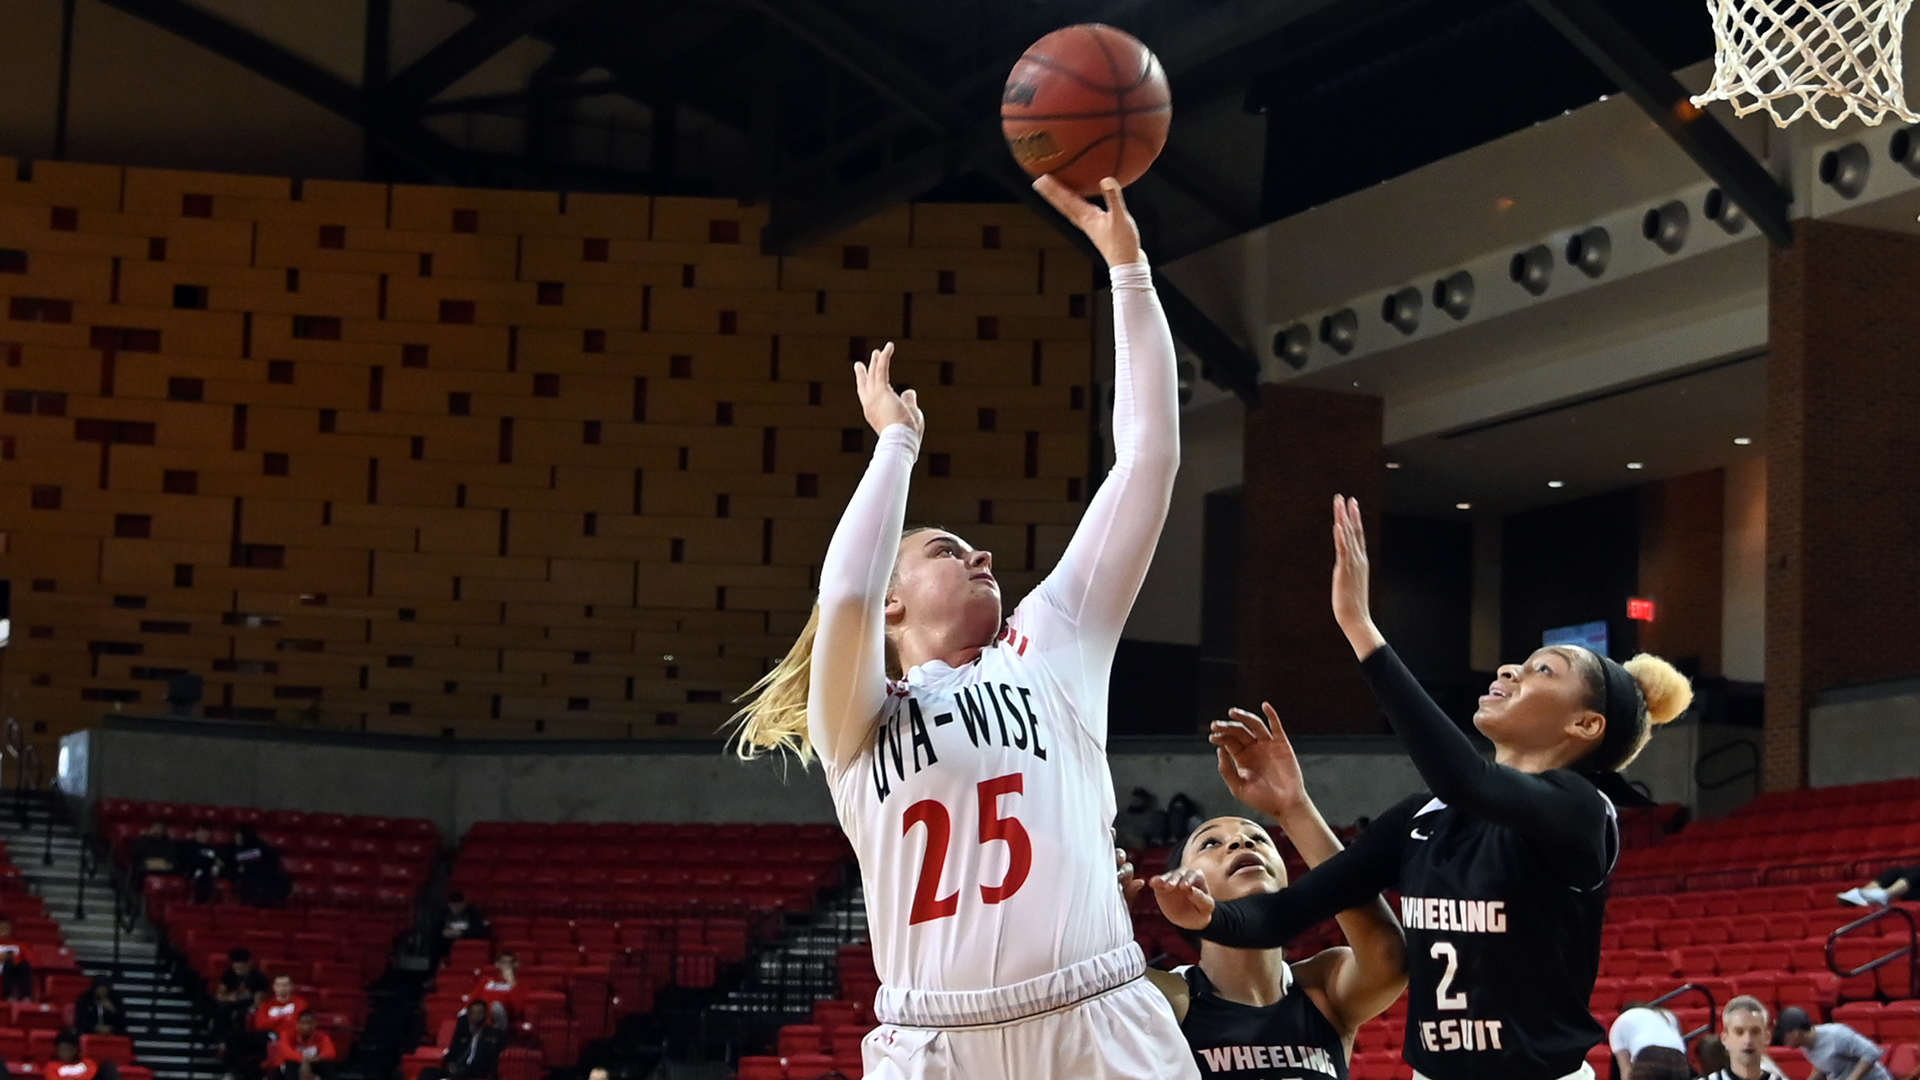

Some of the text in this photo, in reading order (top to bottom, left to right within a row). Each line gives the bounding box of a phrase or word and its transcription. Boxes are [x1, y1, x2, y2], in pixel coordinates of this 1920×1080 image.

[873, 682, 1047, 803] UVA-WISE
[903, 773, 1032, 925] 25
[1400, 896, 1507, 933] WHEELING
[1430, 942, 1467, 1010] 2
[1418, 1019, 1503, 1052] ESUIT
[1197, 1045, 1338, 1079] WHEELING
